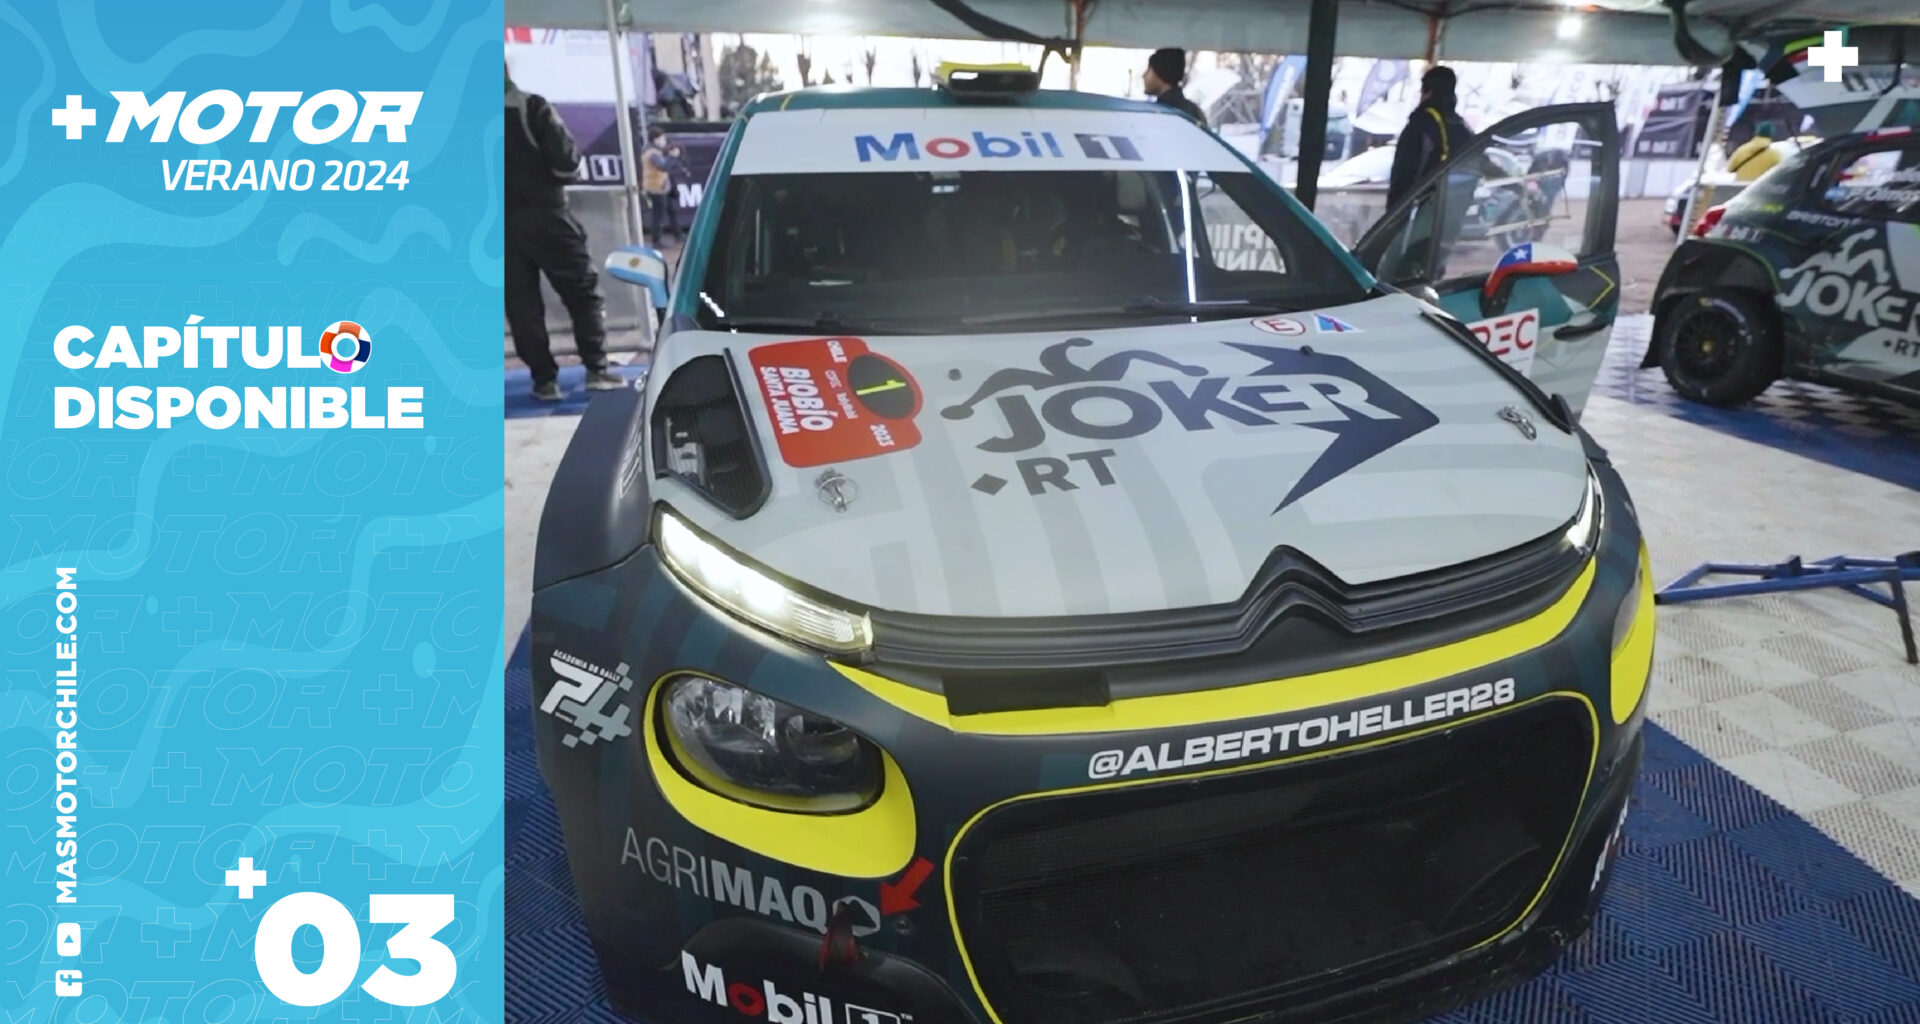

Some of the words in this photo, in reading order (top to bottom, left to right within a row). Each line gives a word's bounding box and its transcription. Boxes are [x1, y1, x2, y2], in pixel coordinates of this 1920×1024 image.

[855, 131, 1064, 162] Mobil
[760, 366, 785, 397] SANTA
[779, 367, 839, 431] BIOBÍO
[856, 379, 906, 395] 1
[771, 398, 800, 435] JUANA
[976, 377, 1402, 453] JOKER
[1016, 448, 1118, 496] RT
[1088, 678, 1516, 780] @ALBERTOHELLER28
[621, 827, 829, 935] AGRIMAQ
[681, 950, 833, 1024] Mobil
